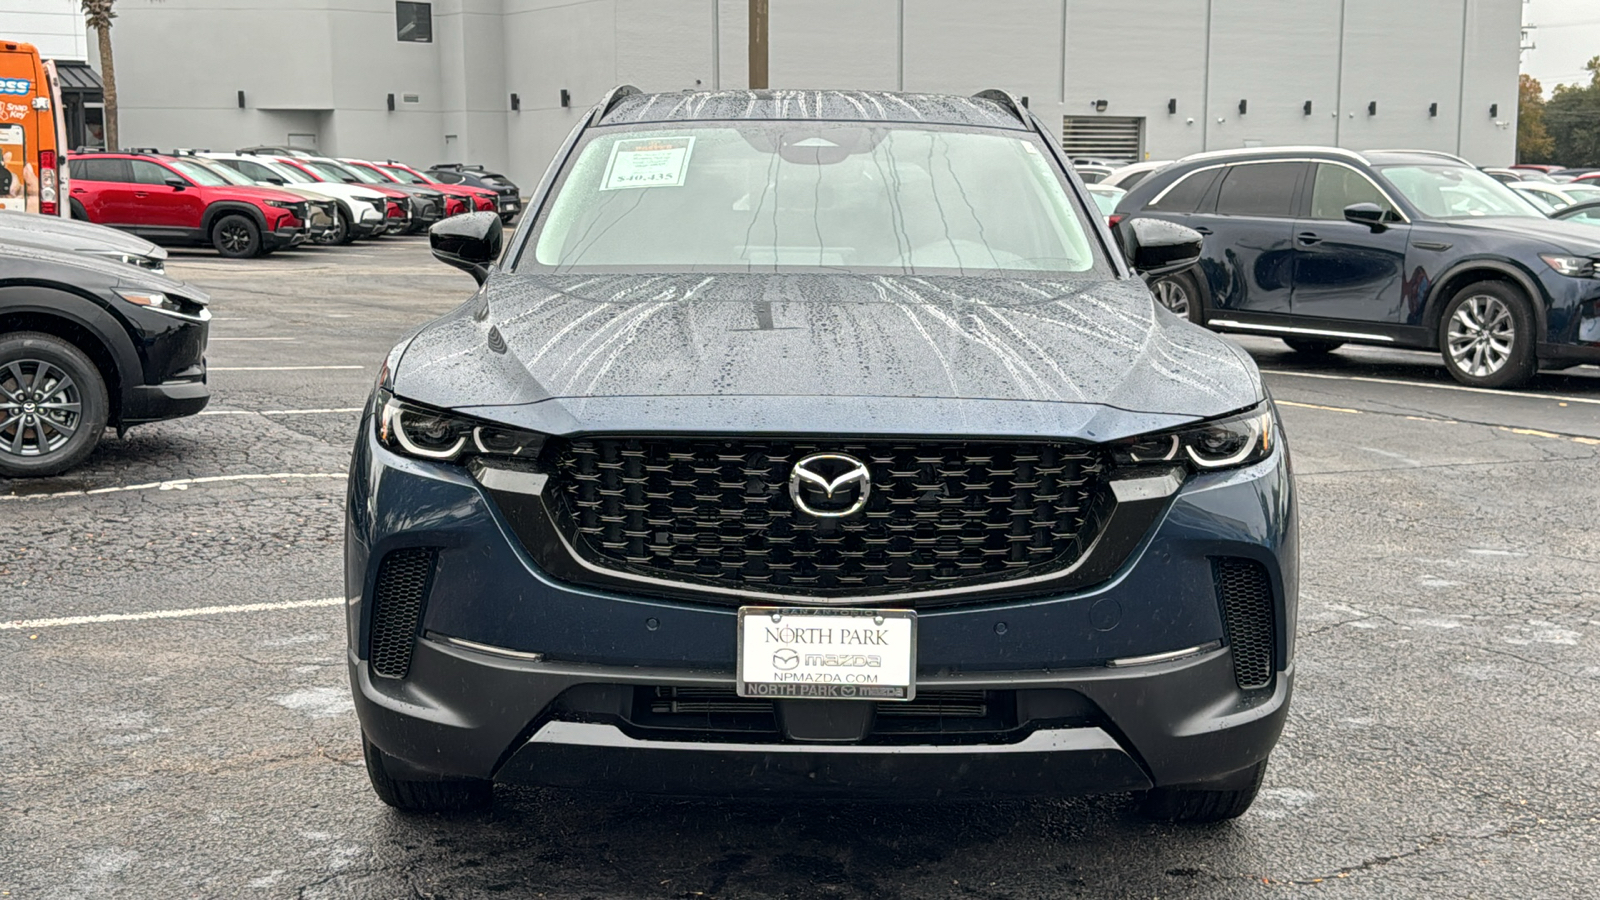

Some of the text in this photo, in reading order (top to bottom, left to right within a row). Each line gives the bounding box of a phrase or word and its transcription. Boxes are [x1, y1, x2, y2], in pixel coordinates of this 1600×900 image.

[6, 103, 28, 111] Snap
[10, 110, 29, 119] Key
[765, 626, 889, 646] NORTH PARK
[805, 654, 882, 667] mazda
[774, 672, 878, 683] NPMAZDA.COM
[747, 684, 904, 697] NORTH PARK mazda
